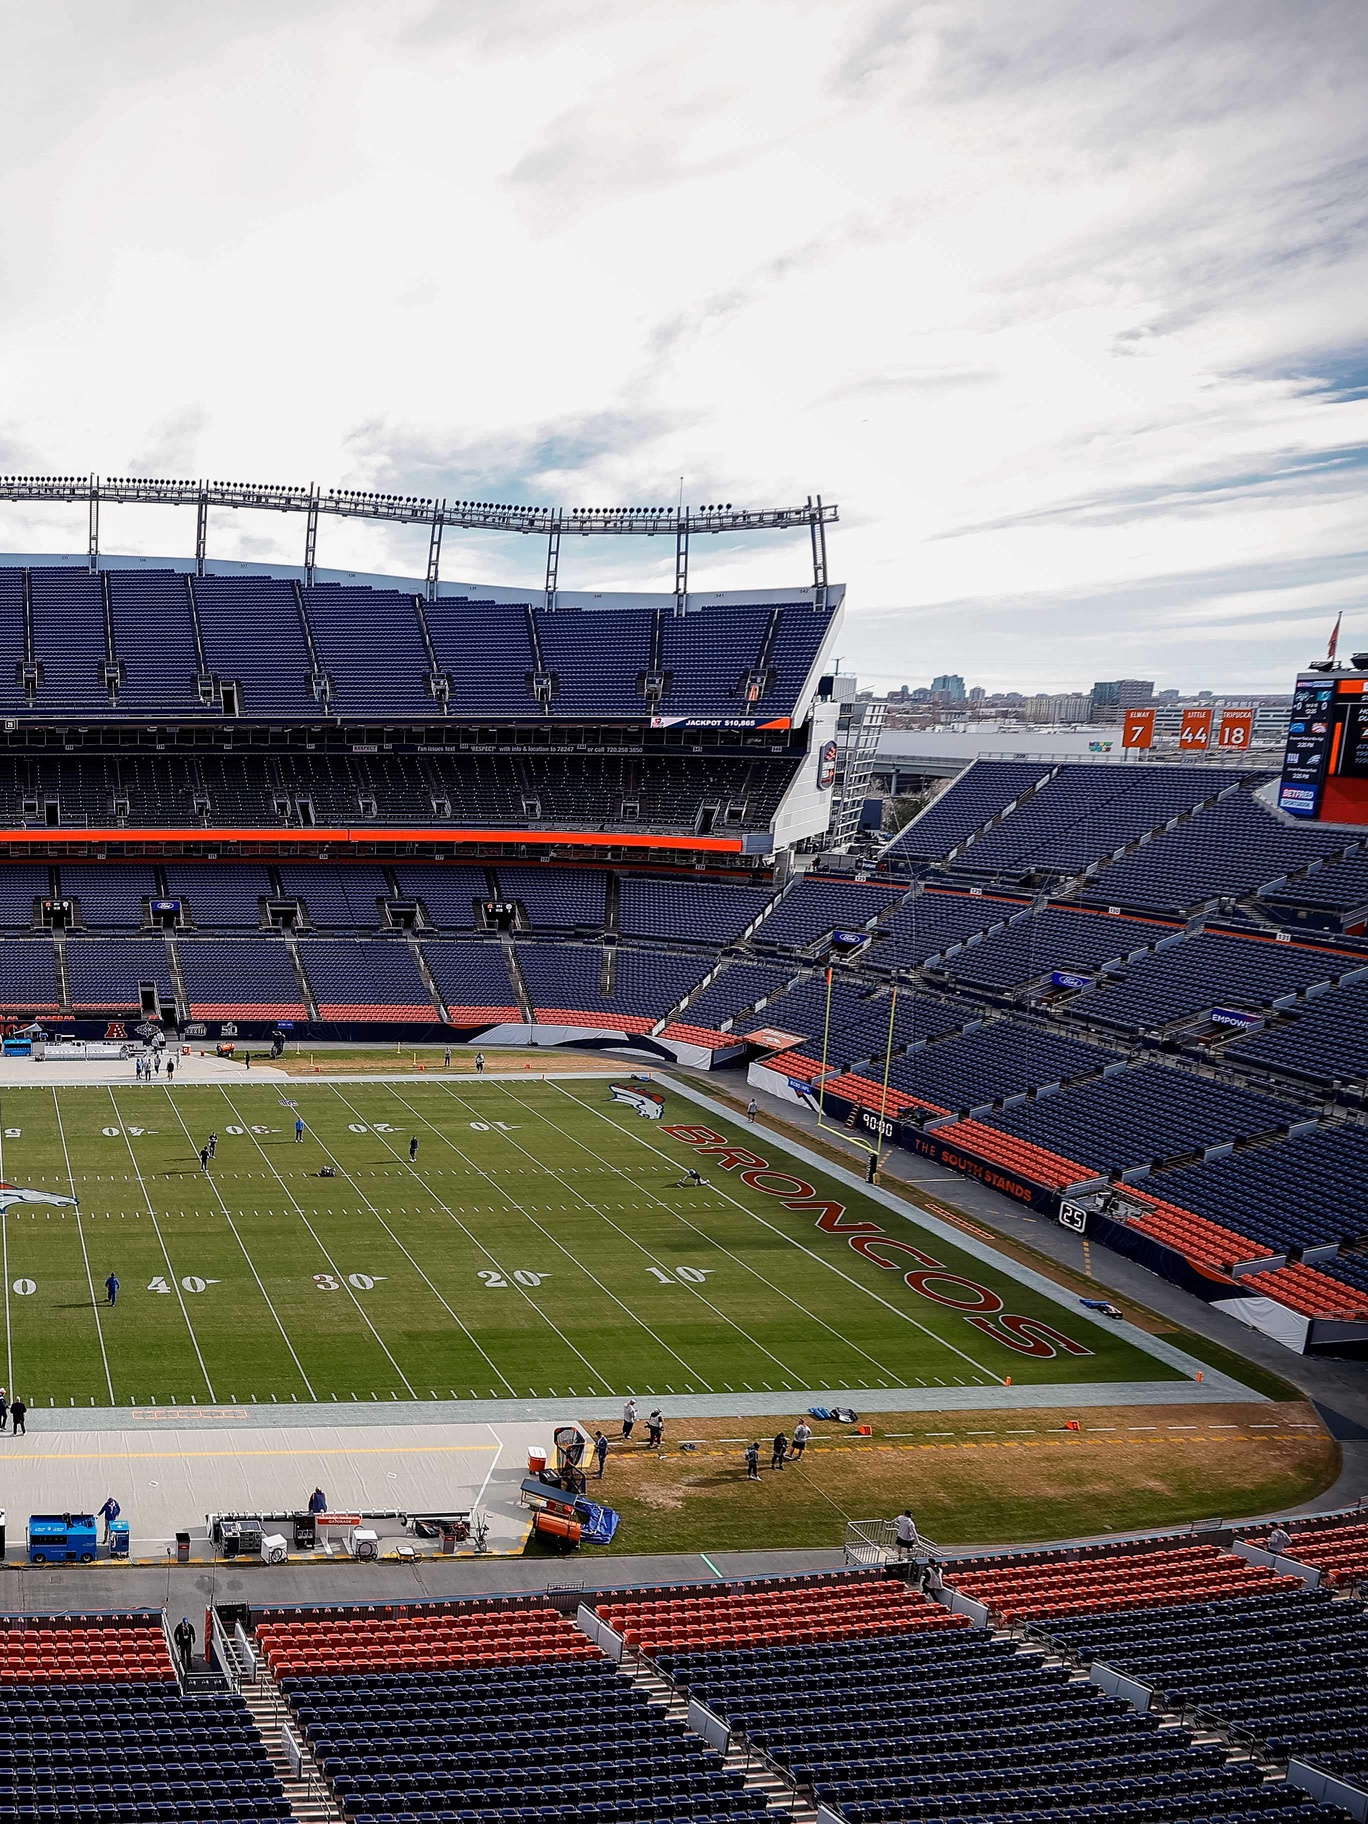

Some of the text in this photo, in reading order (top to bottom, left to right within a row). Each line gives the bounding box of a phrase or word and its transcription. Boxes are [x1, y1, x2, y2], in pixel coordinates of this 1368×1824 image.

[685, 719, 722, 727] JACKPOT
[1131, 726, 1144, 743] 7
[1182, 726, 1207, 744] 44
[1223, 727, 1245, 744] 18
[1283, 788, 1314, 799] BETFRED
[762, 1028, 805, 1043] GEICO
[101, 1126, 145, 1138] 40
[225, 1125, 270, 1136] 30
[348, 1123, 396, 1135] 20
[469, 1120, 513, 1132] 10
[862, 1113, 893, 1137] 90:00
[915, 1139, 1032, 1201] THE SOUTH STANDS
[1063, 1207, 1083, 1228] 25
[656, 1122, 1096, 1360] BRONCOS
[311, 1273, 374, 1291] 30
[477, 1270, 541, 1288] 20
[645, 1266, 707, 1284] 10
[146, 1276, 207, 1294] 40
